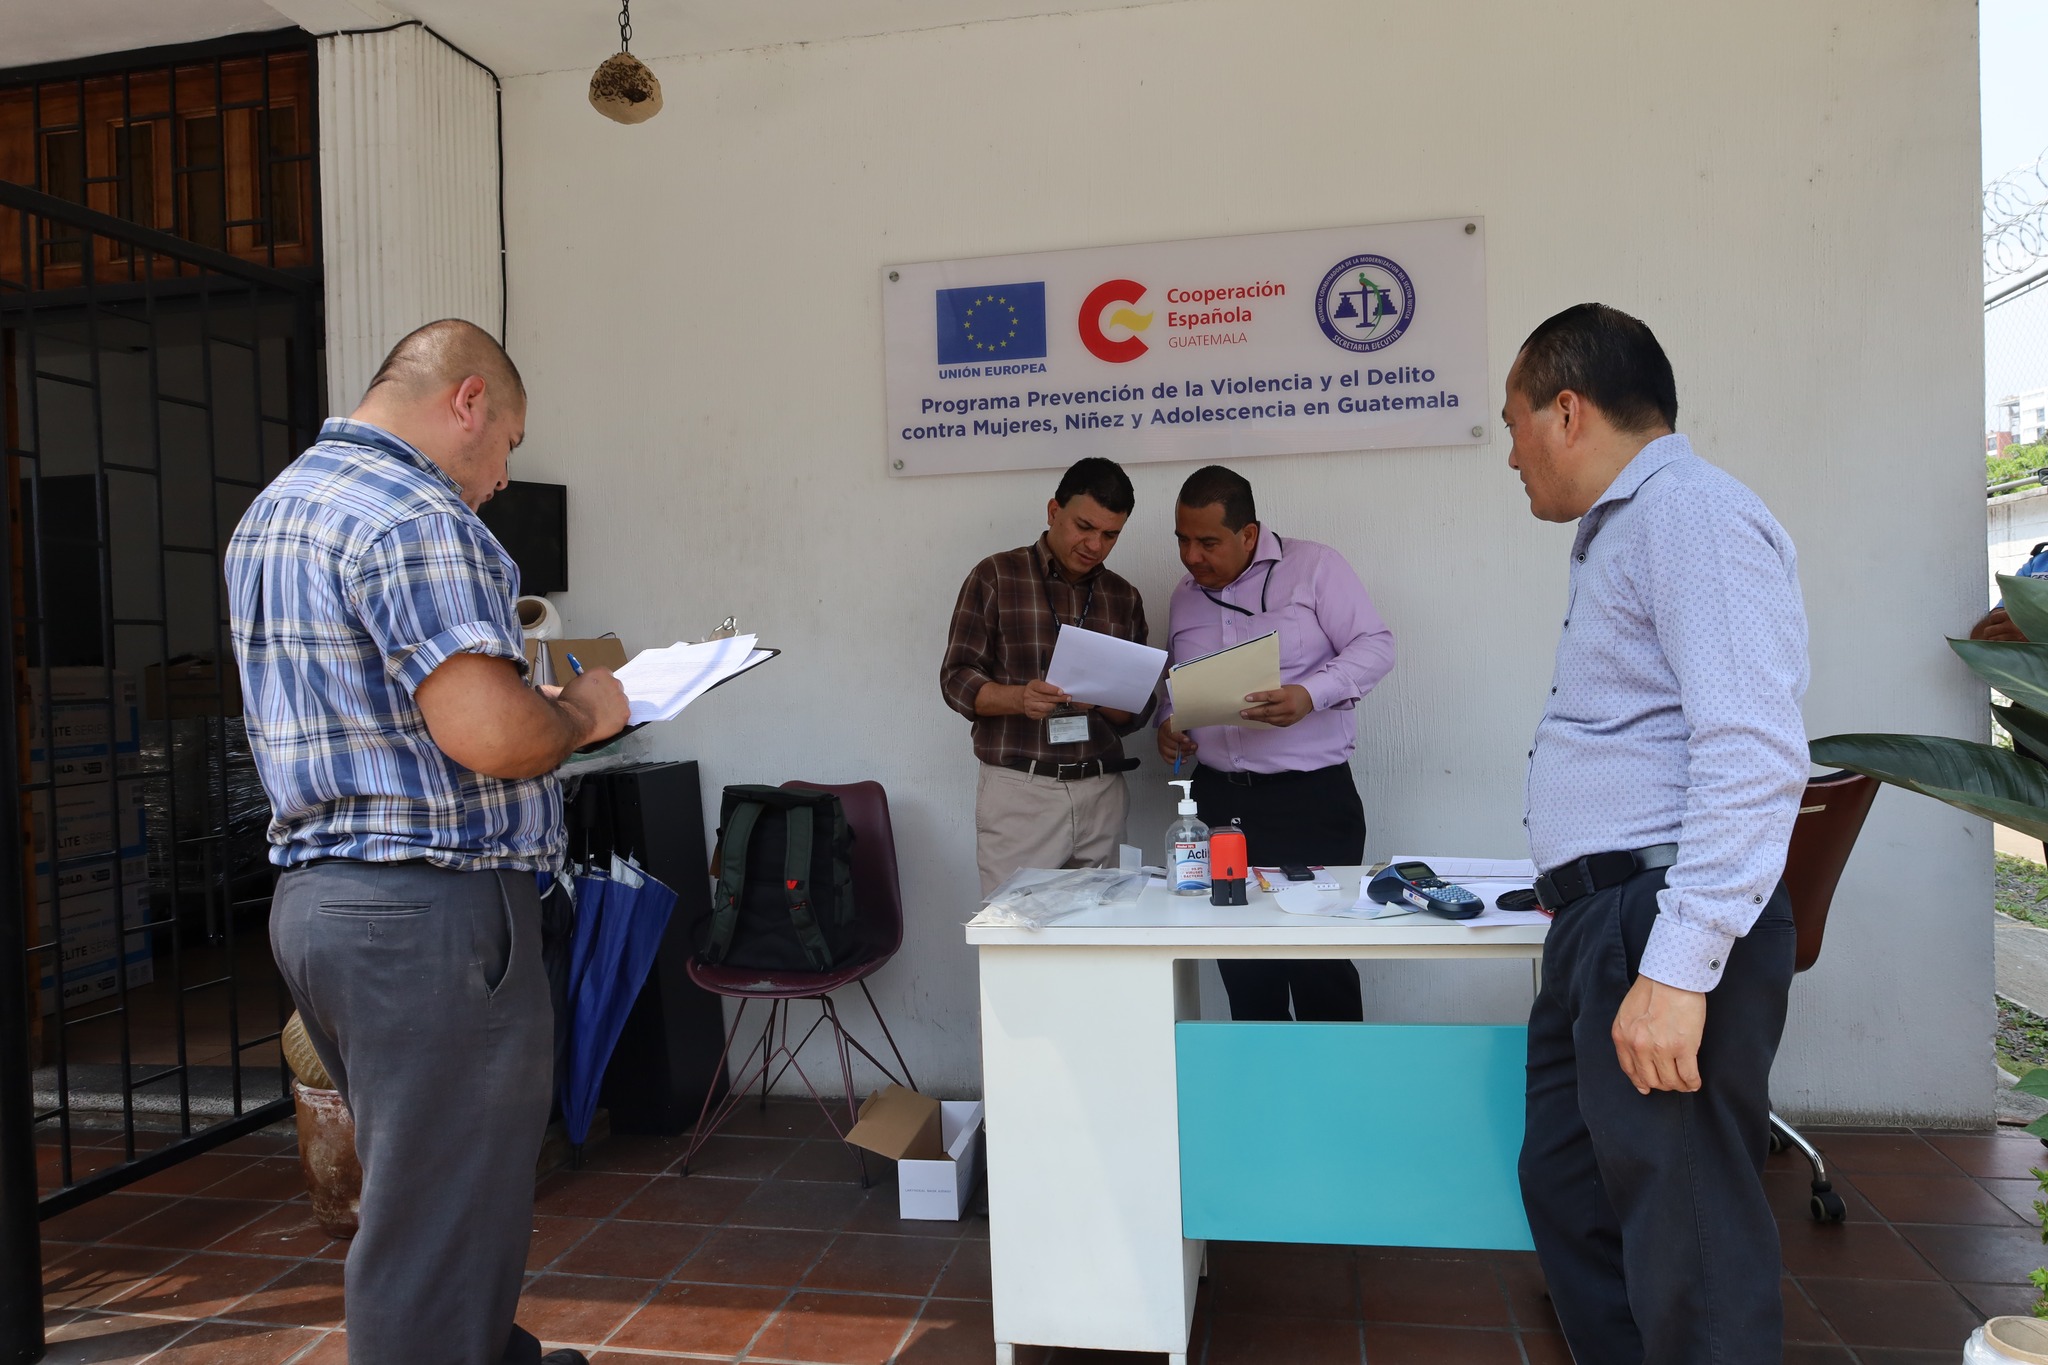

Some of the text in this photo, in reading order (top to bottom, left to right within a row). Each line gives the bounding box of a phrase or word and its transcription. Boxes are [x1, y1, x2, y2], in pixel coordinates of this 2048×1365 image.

[1319, 264, 1345, 297] COORDINADORA
[1398, 272, 1406, 282] DEL
[1167, 280, 1286, 306] Cooperación
[1403, 280, 1412, 298] SECTOR
[1168, 306, 1252, 330] Española
[1405, 299, 1413, 319] JUSTICIA
[1168, 332, 1248, 348] GUATEMALA
[1332, 329, 1402, 351] SECRETARIA EJECUTIVA
[938, 363, 1047, 380] UNIÓN EUROPEA
[921, 366, 1436, 415] Programa Prevención de la Violencia y el Delito
[901, 391, 1460, 441] contra Mujeres, Niñez y Adolescencia en Guatemala
[1187, 848, 1210, 859] Acti
